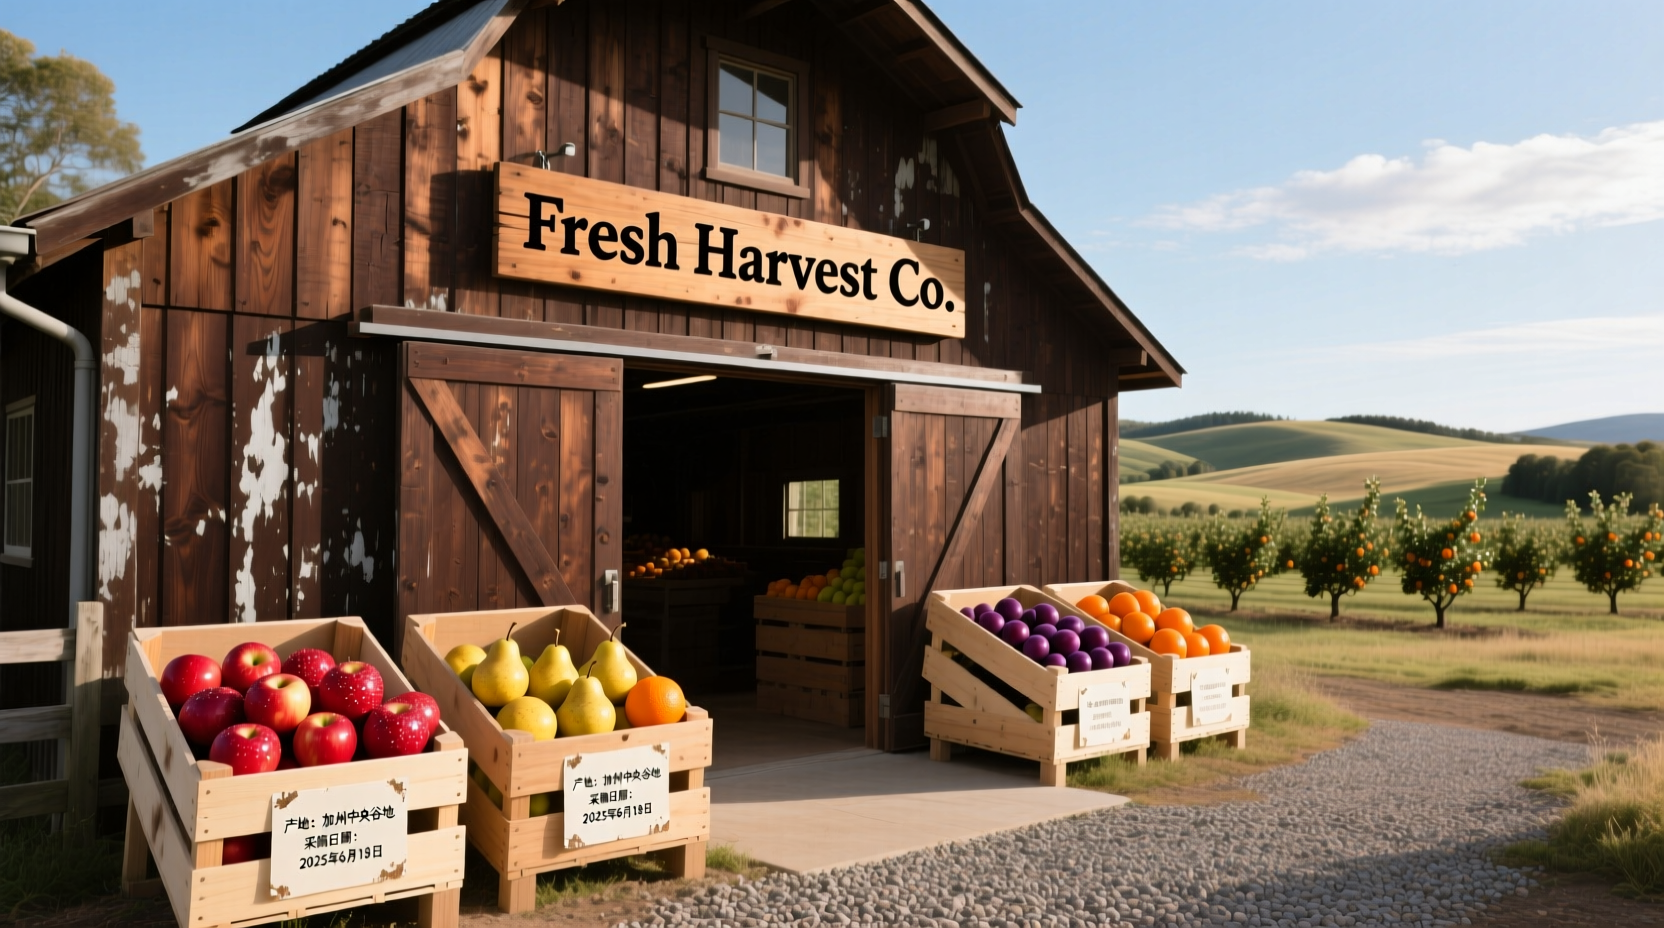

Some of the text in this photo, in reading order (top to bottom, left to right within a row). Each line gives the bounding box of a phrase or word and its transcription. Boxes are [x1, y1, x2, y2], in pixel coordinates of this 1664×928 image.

[523, 192, 955, 312] Fresh Harvest Co.
